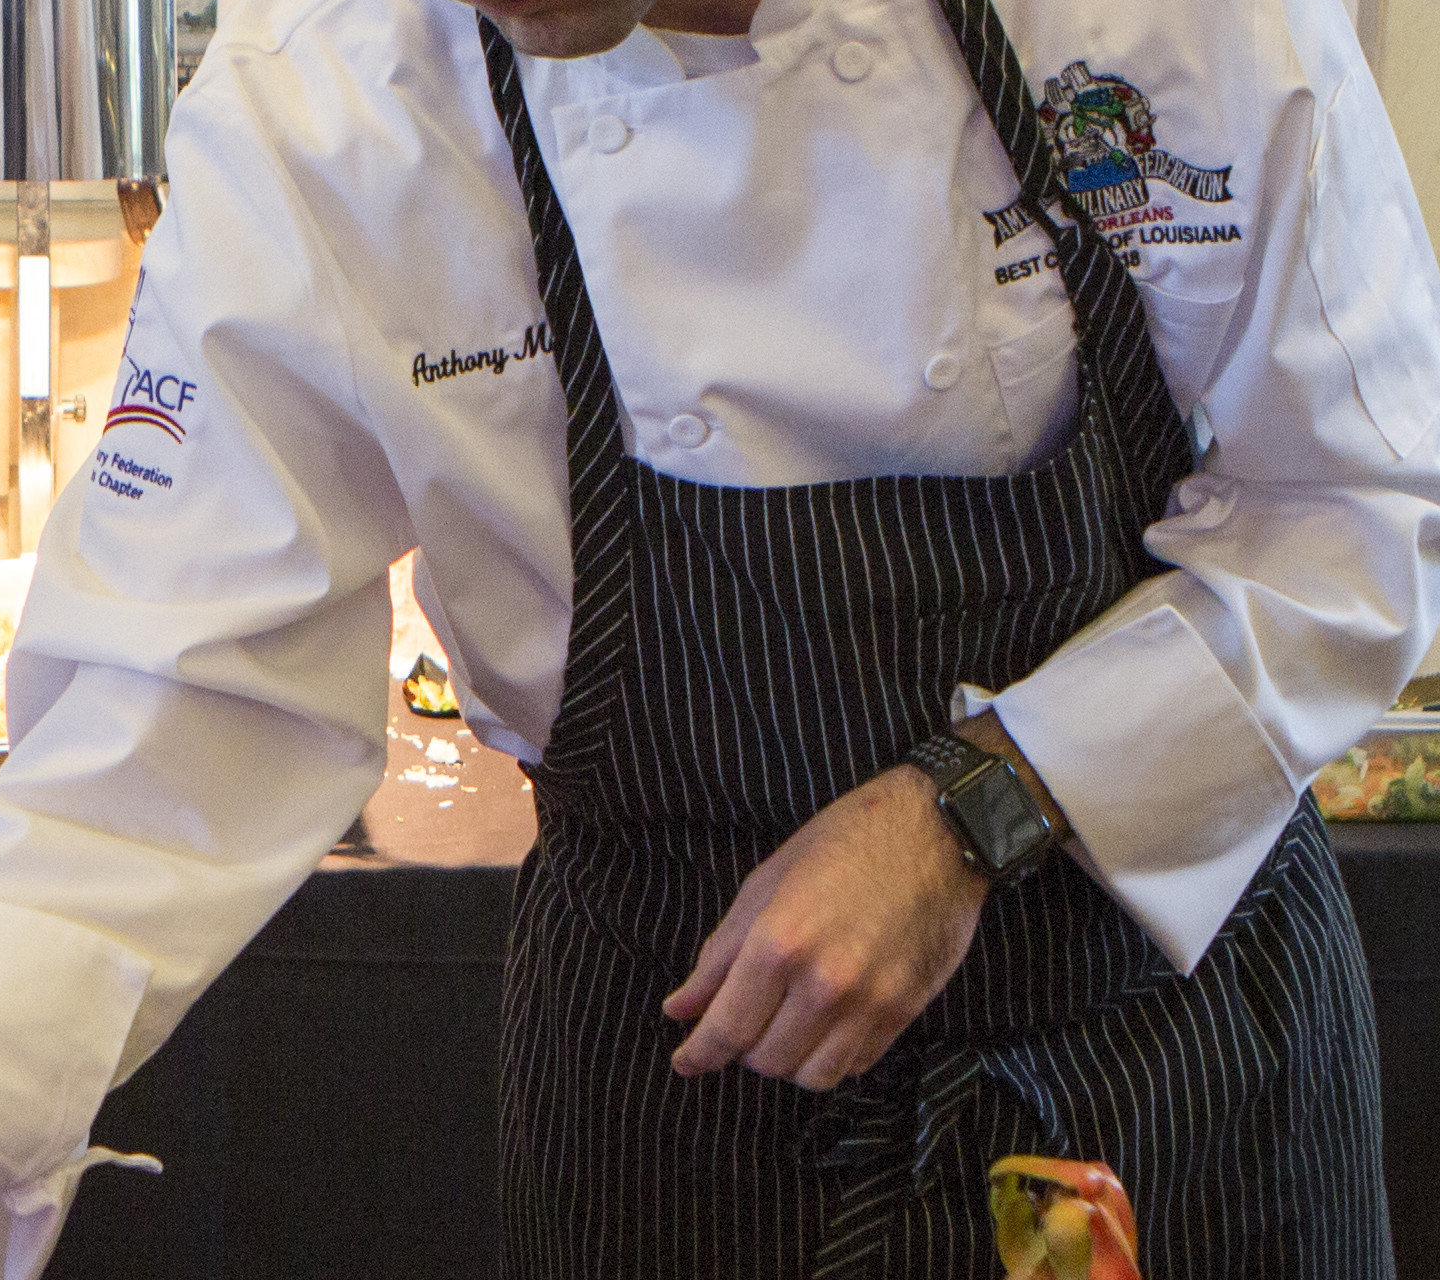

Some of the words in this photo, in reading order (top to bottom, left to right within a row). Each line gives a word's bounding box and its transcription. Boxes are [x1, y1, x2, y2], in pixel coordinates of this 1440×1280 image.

[1134, 151, 1224, 201] FEDERATION
[1096, 206, 1174, 232] ORLEANS
[1109, 228, 1135, 248] OF
[1140, 223, 1242, 245] LOUISIANA
[994, 254, 1041, 286] BEST
[412, 349, 509, 387] Anthony
[131, 369, 197, 412] ACF
[99, 470, 144, 500] Chapter
[111, 451, 173, 489] Federation
